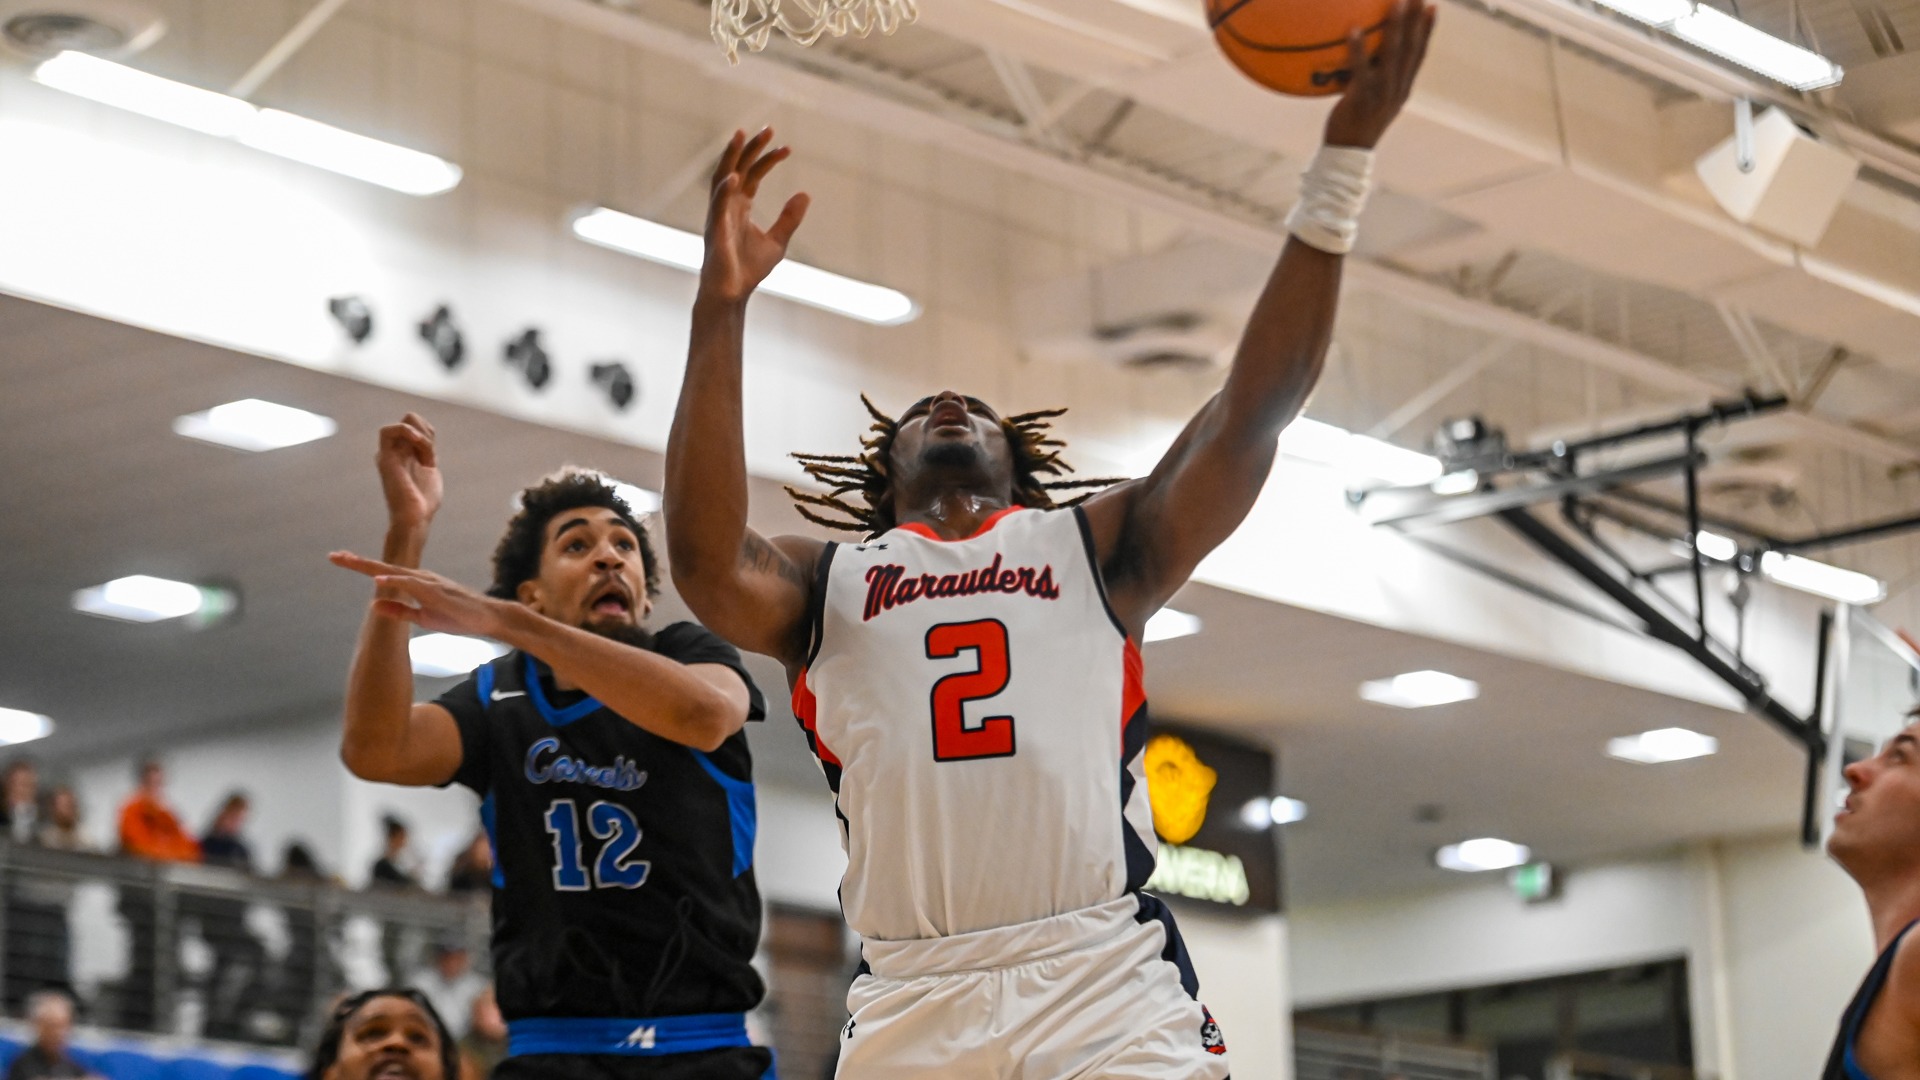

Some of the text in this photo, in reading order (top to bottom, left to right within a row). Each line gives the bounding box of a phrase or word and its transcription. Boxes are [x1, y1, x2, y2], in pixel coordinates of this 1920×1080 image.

[863, 552, 1060, 622] Marauders
[924, 617, 1016, 763] 2
[543, 799, 651, 891] 12
